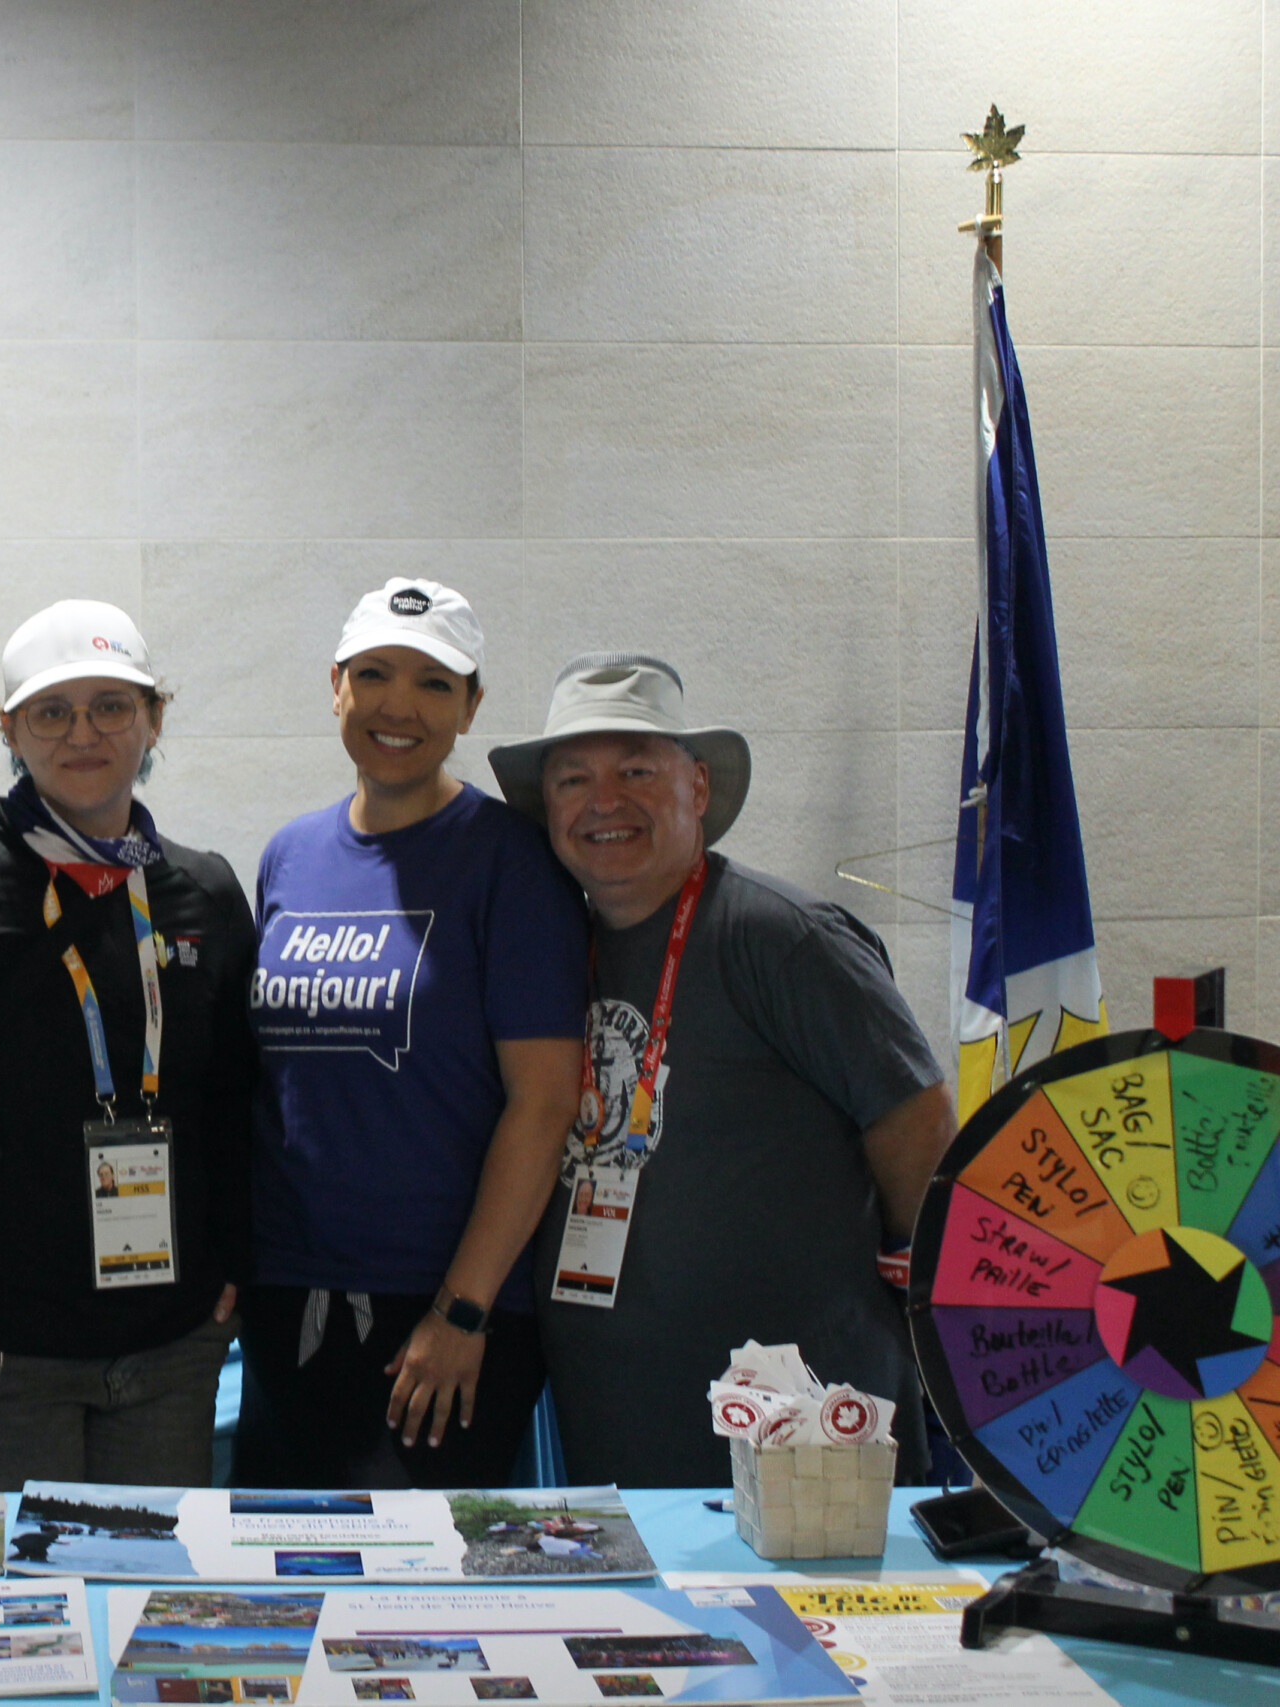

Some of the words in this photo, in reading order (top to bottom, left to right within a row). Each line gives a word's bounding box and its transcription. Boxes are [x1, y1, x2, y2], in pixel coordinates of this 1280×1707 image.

[279, 924, 390, 962] Hello!
[249, 967, 401, 1018] Bonjour!
[1080, 1107, 1124, 1170] SAC
[1001, 1172, 1055, 1217] PEN
[1158, 1456, 1191, 1511] PEN
[395, 1593, 511, 1603] francophonie
[420, 1602, 443, 1610] de
